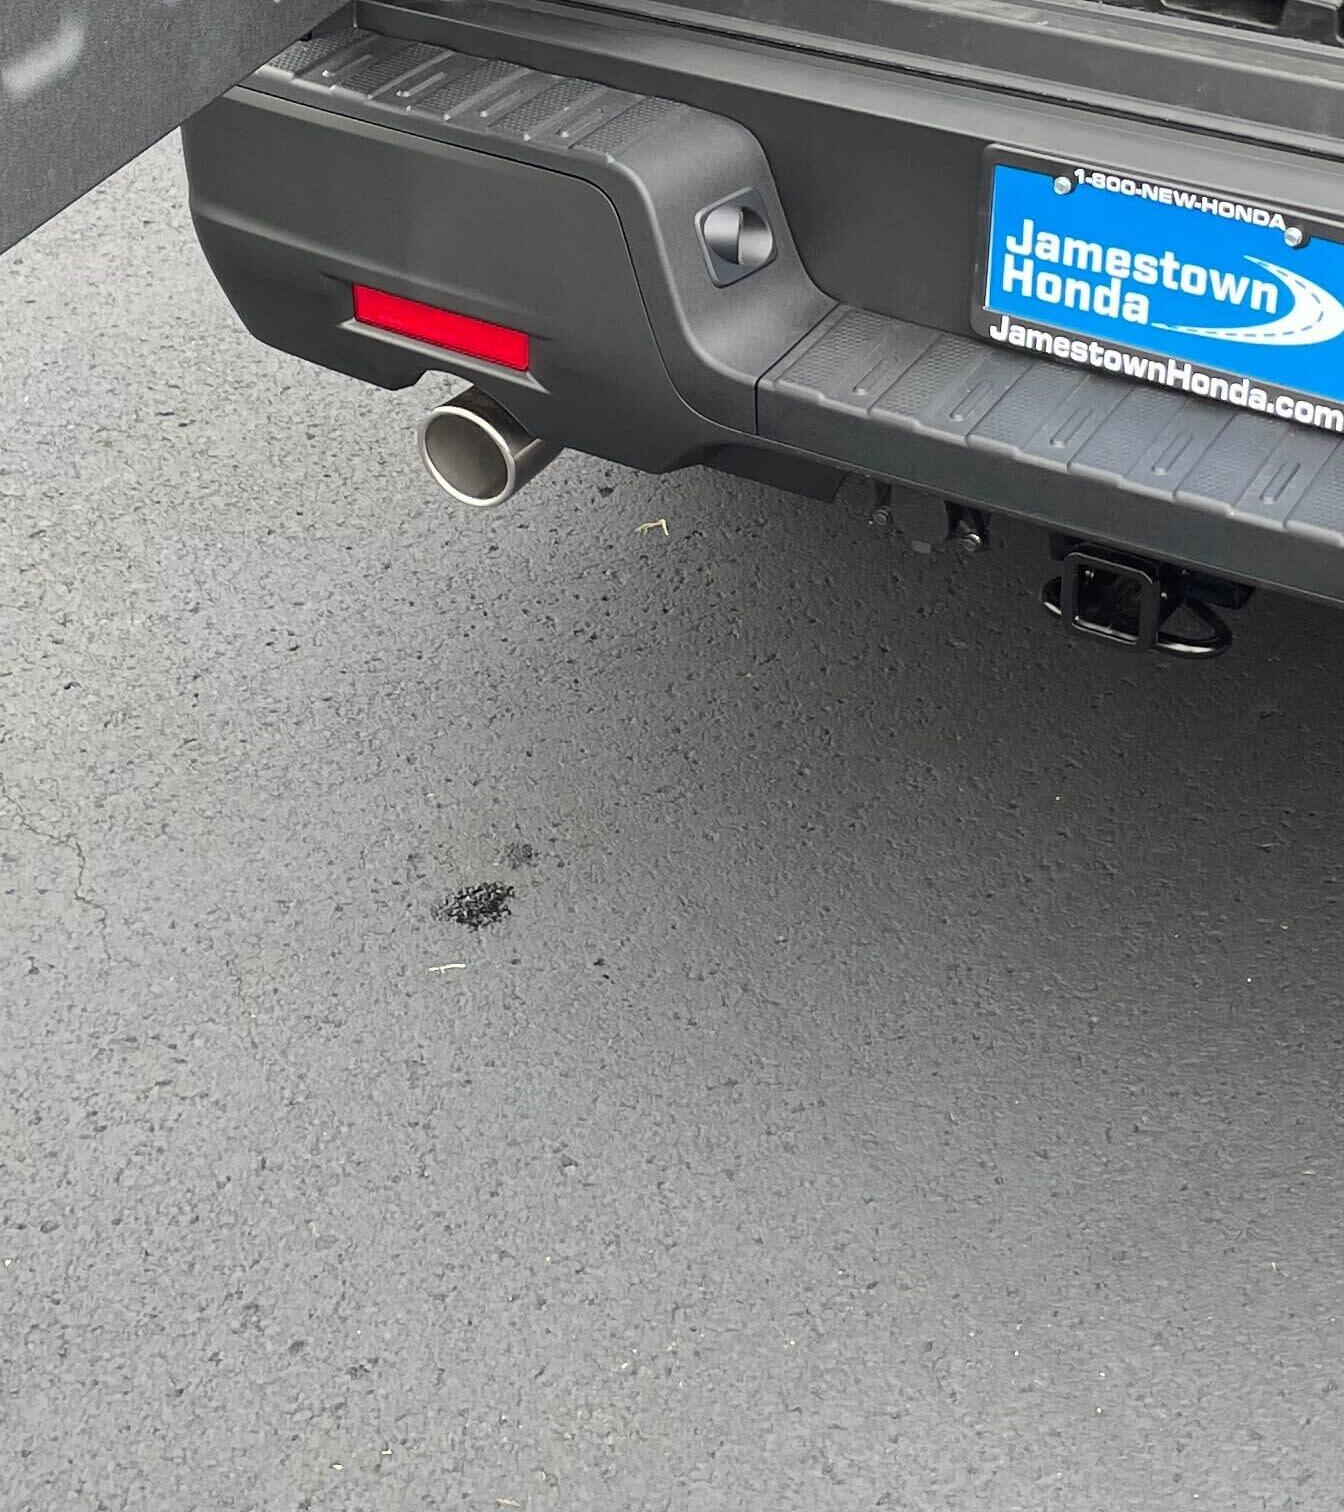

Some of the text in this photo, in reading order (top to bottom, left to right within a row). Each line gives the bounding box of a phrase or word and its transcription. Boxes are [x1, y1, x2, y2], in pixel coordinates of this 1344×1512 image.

[1074, 167, 1287, 232] 1-800-NEW-HONDA
[1002, 253, 1151, 326] Honda
[1005, 218, 1278, 315] Jamestown
[989, 315, 1344, 433] JamestownHonda.com
